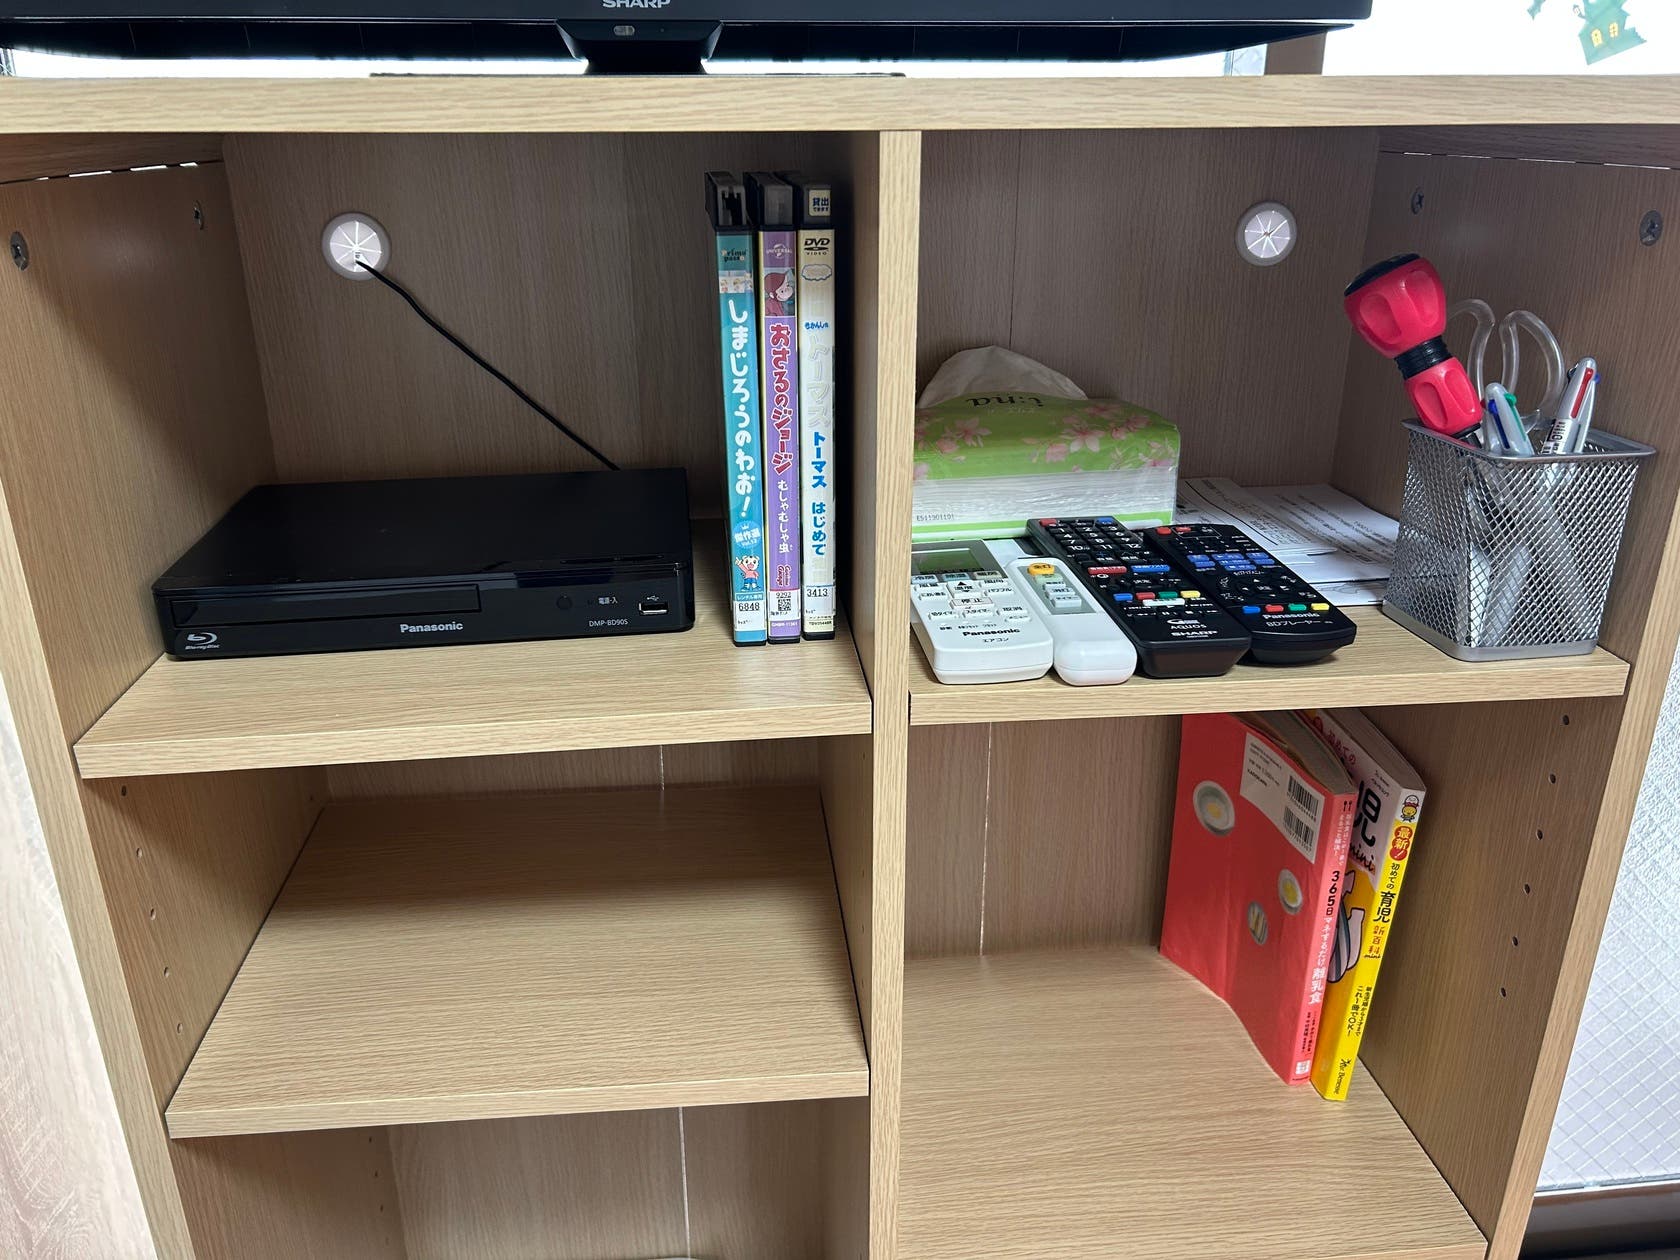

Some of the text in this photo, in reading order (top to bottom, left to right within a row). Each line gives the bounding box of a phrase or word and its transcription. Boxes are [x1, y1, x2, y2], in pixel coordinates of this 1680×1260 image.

[602, 0, 671, 8] SHARP
[804, 238, 831, 247] DVD
[769, 323, 794, 553] おさるのジョージ むしゃむしゃ虫
[811, 431, 827, 489] トーマス
[811, 502, 827, 556] はじめて
[806, 588, 828, 598] 3413
[738, 602, 760, 611] 6848
[400, 621, 463, 633] Panasonic
[588, 618, 629, 627] DMP-BD90S
[962, 628, 1021, 637] Panasonic
[1393, 826, 1412, 858] 最新!
